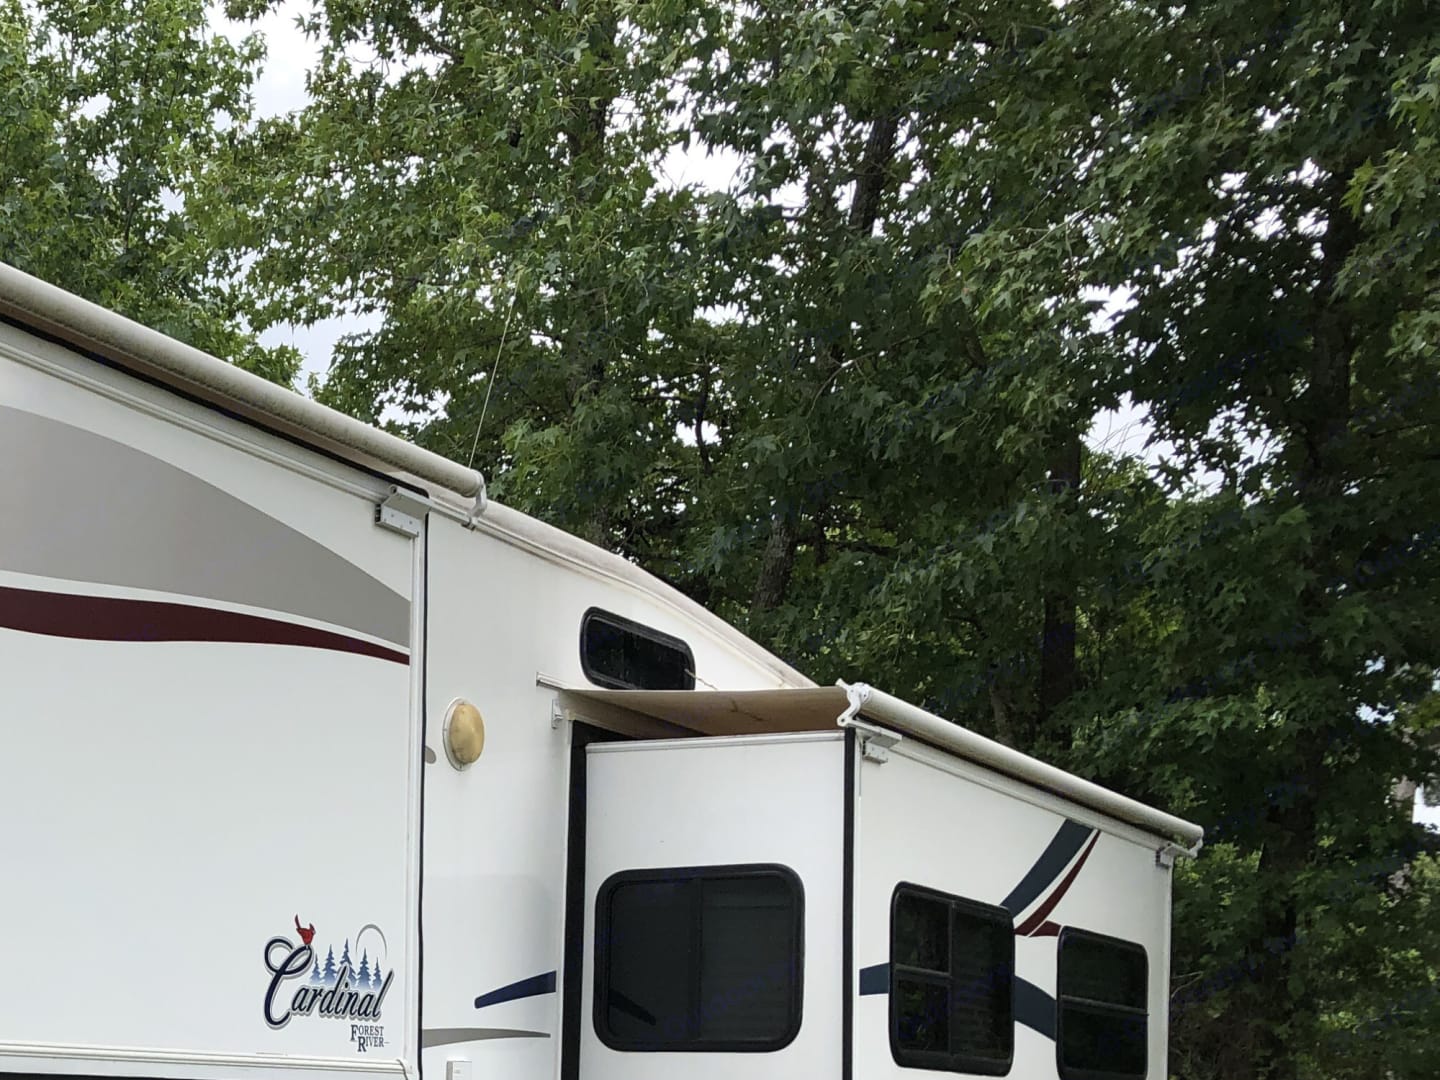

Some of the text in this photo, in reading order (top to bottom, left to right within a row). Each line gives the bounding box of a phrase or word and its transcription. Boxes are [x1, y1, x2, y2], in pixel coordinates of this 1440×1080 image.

[264, 937, 393, 1029] Cardinal
[350, 1024, 385, 1041] FOREST
[357, 1036, 385, 1052] RIVER
